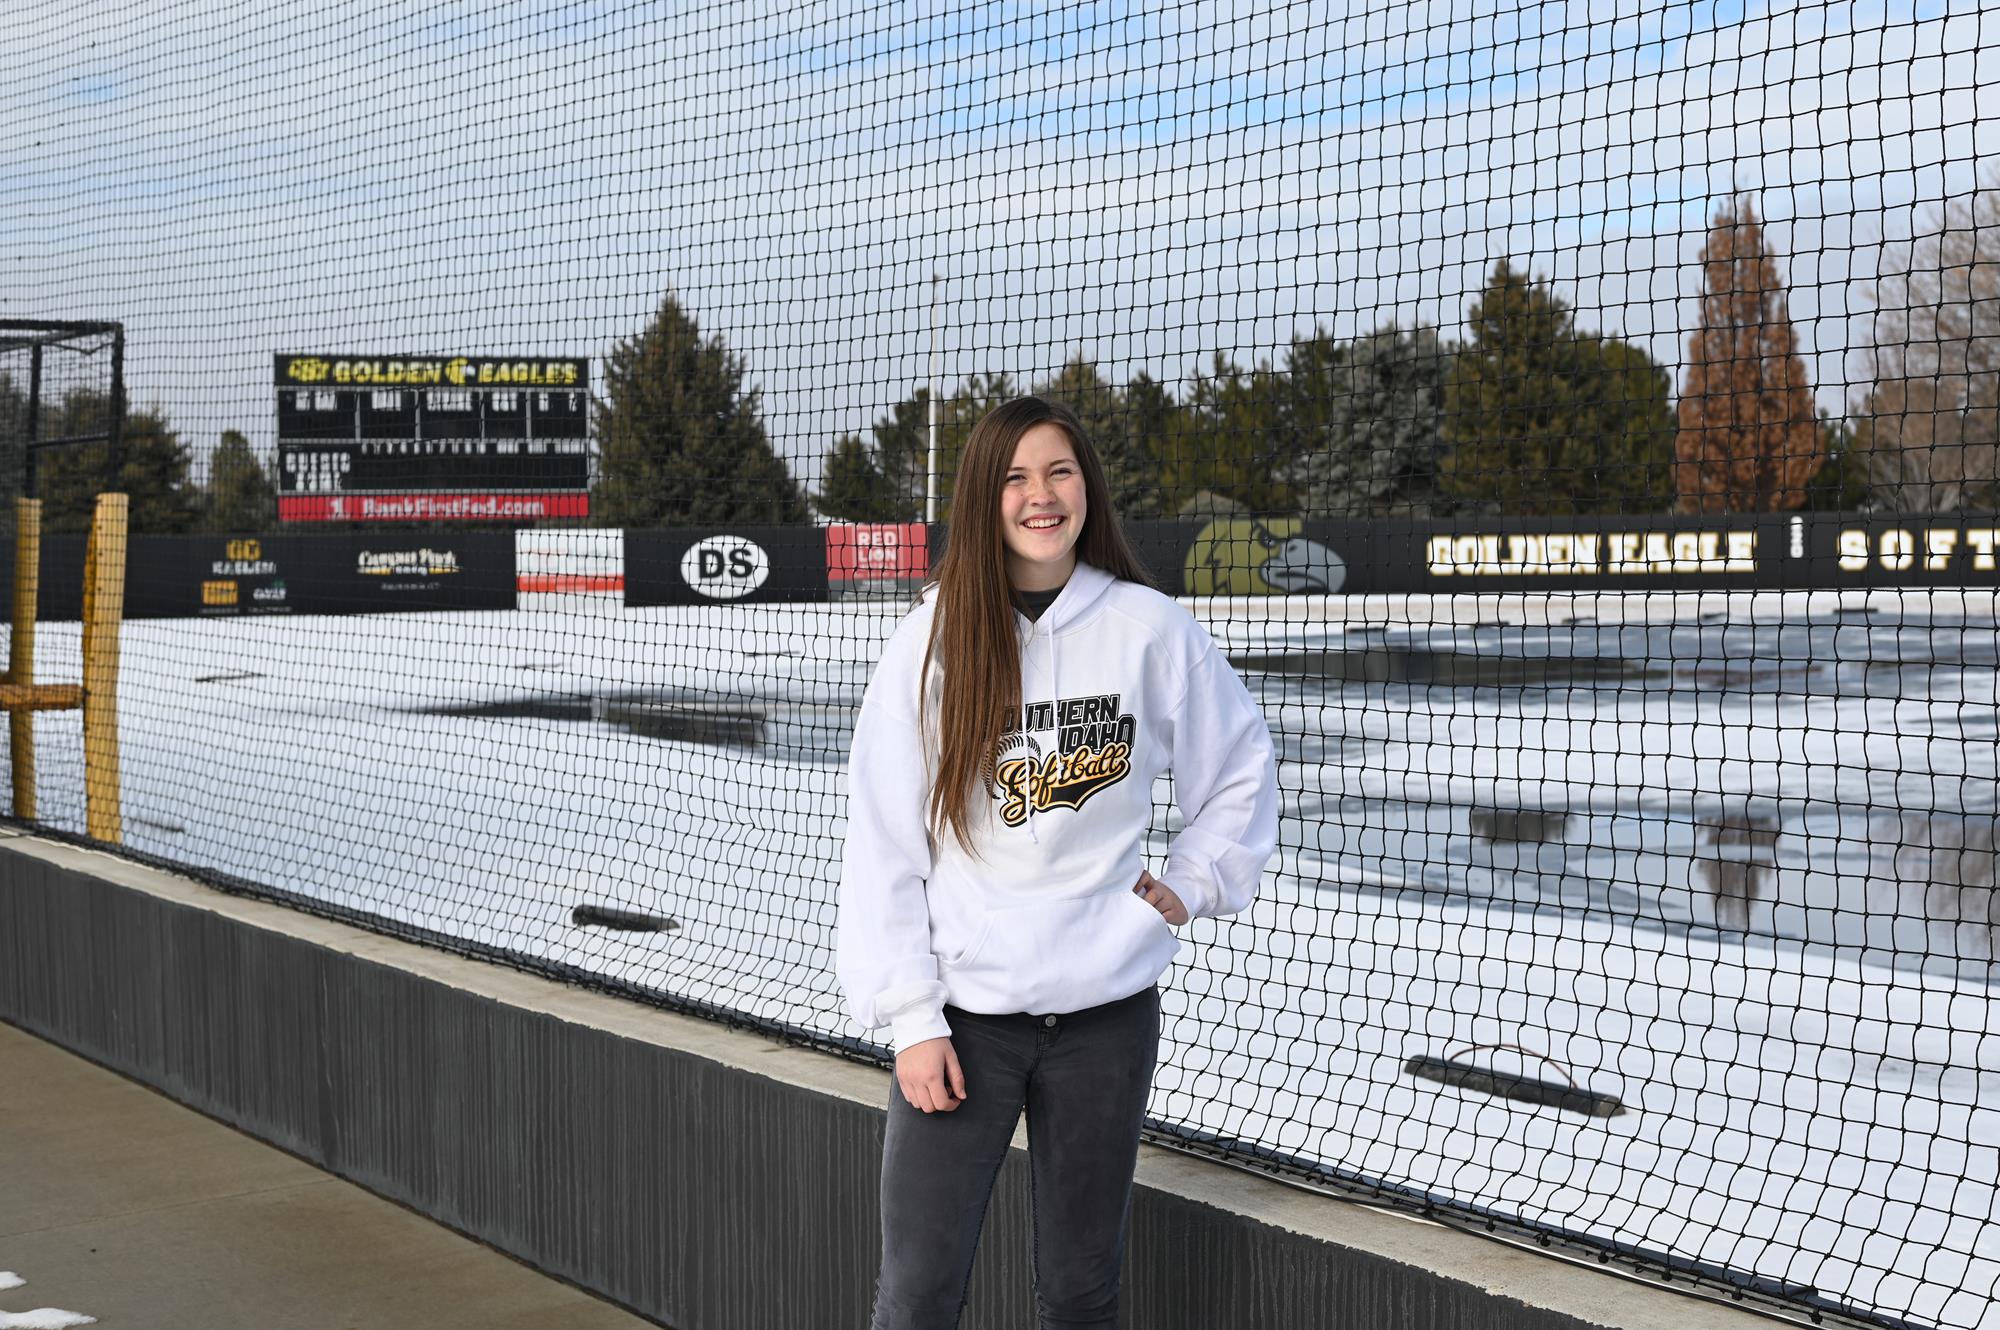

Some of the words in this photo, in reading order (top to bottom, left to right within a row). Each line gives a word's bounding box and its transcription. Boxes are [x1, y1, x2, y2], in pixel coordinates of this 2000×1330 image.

[333, 361, 442, 384] GOLDEN
[478, 362, 579, 385] EAGLES
[857, 531, 898, 546] RED
[1427, 533, 1601, 576] GOLDEN
[1608, 531, 1758, 573] EAGLE
[699, 549, 753, 578] DS
[1058, 714, 1137, 755] IDAHO
[997, 741, 1130, 827] Softball
